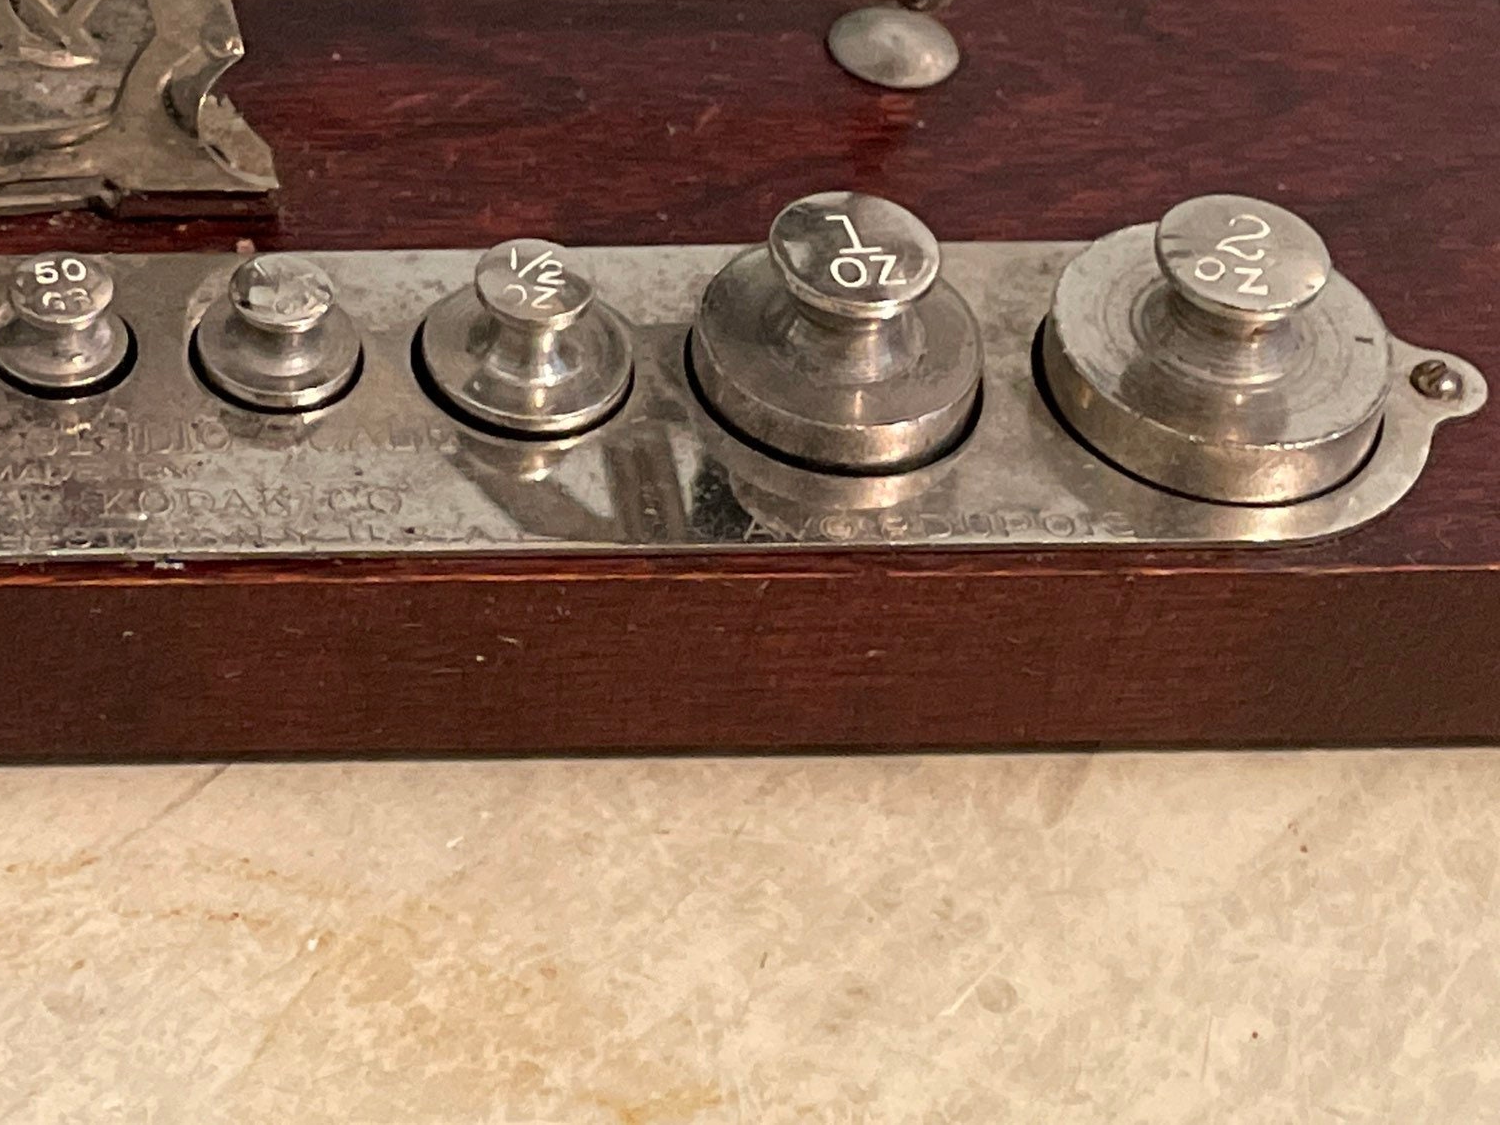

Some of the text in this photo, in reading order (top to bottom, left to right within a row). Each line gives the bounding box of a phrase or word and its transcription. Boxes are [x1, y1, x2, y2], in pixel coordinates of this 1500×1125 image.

[825, 215, 882, 254] 1
[1216, 213, 1271, 261] 2
[33, 259, 87, 284] 50
[509, 247, 566, 286] 1/2
[830, 255, 907, 288] OZ
[101, 486, 294, 519] KODAK
